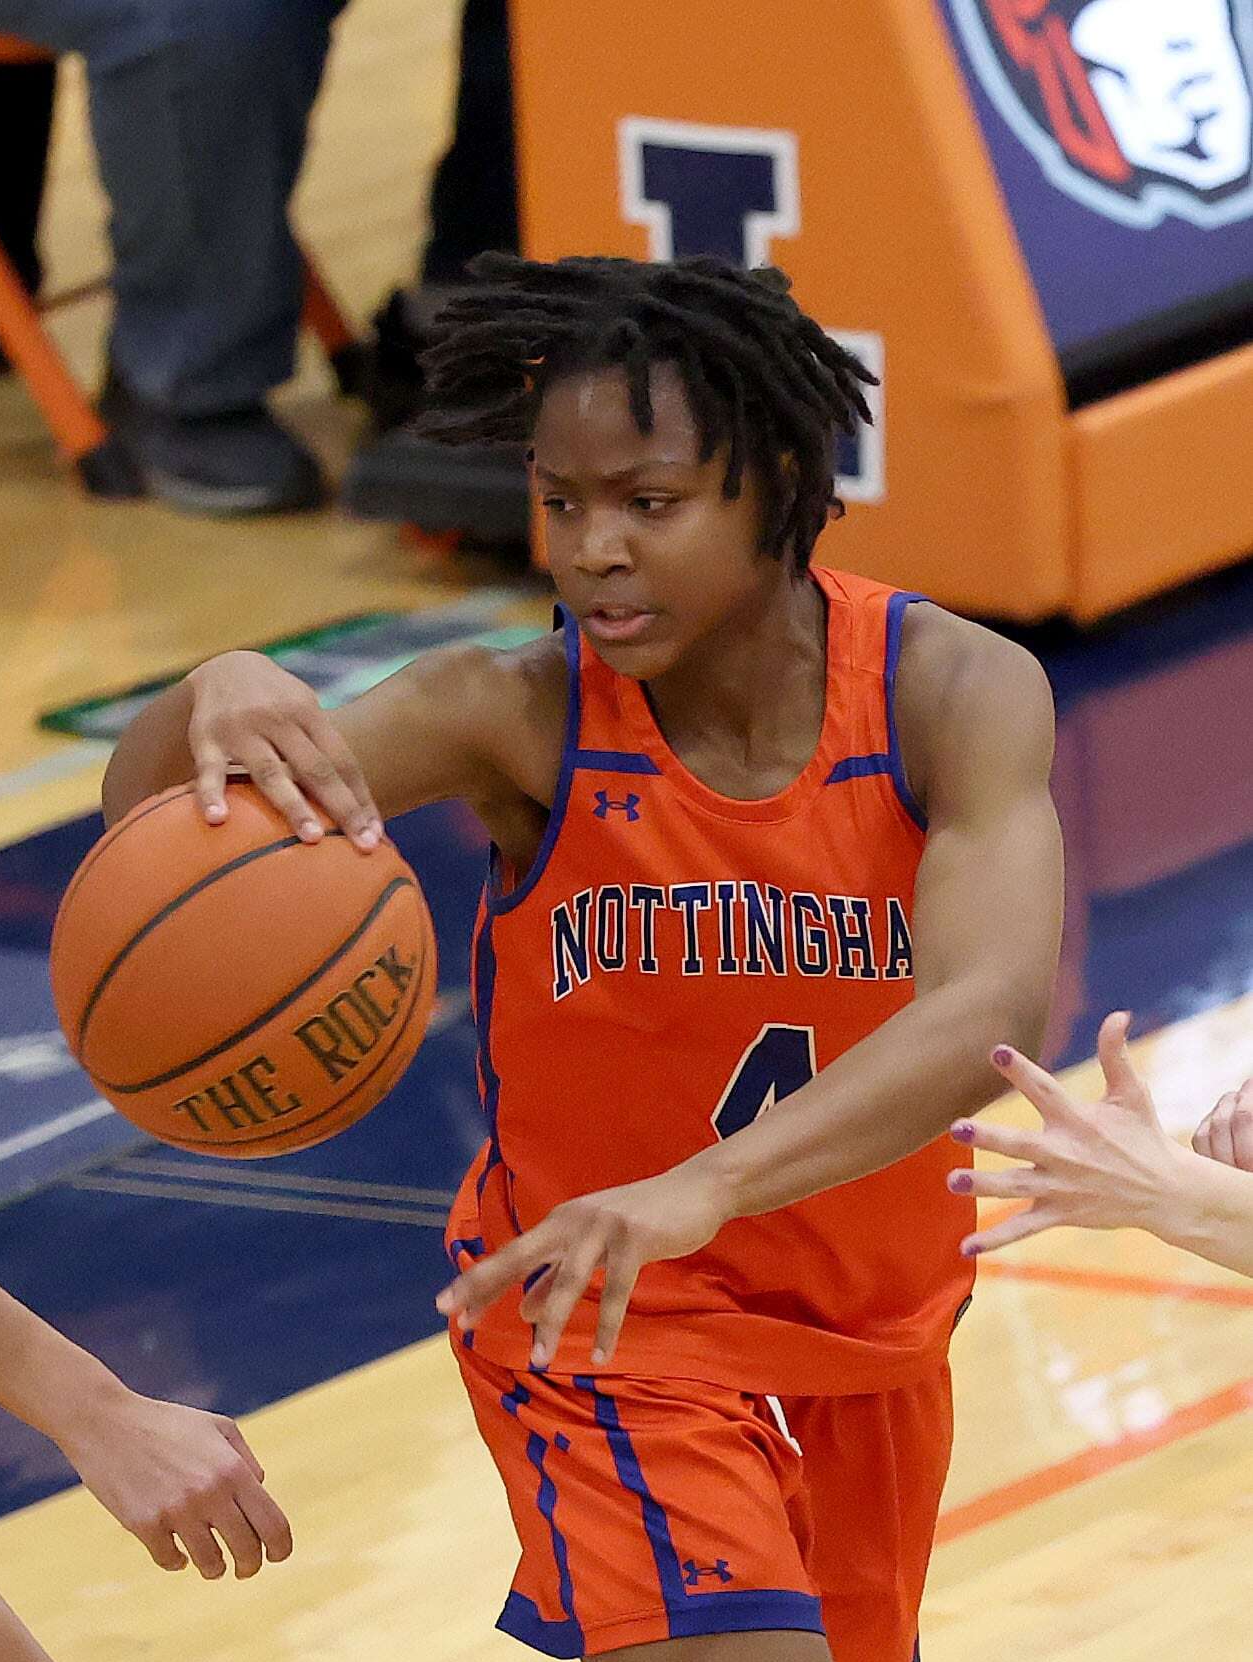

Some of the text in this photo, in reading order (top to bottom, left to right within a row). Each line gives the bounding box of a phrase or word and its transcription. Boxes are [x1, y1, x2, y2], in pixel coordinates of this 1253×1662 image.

[550, 881, 913, 1002] NOTTINGHA
[173, 944, 413, 1133] THE ROCK
[710, 1022, 817, 1141] 4
